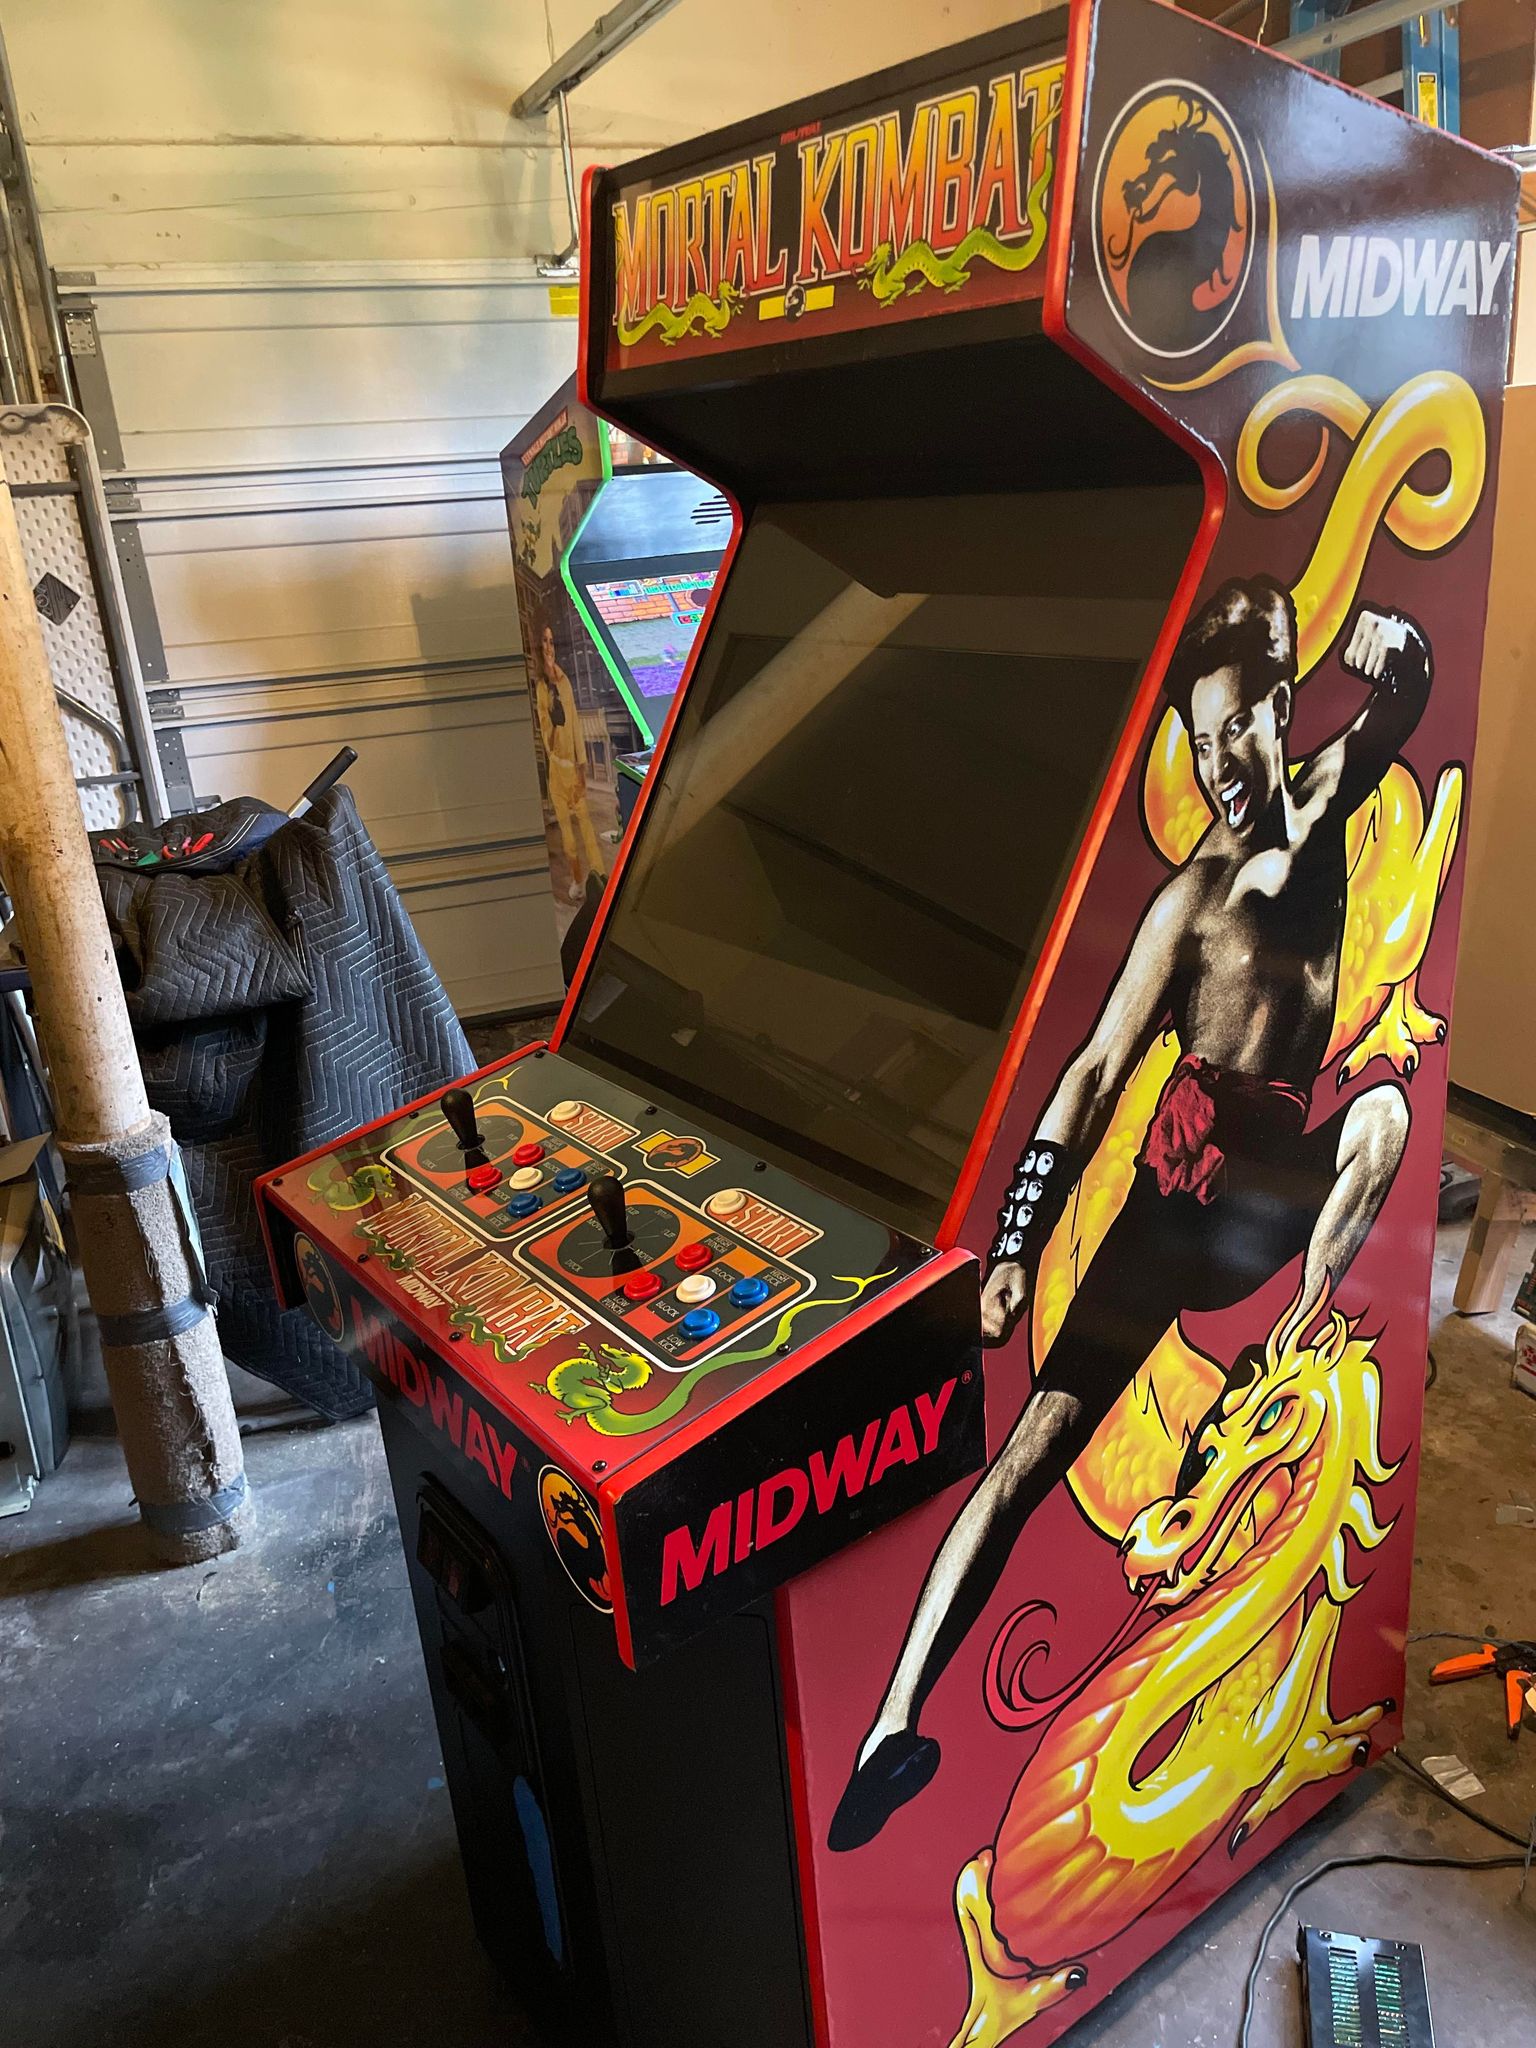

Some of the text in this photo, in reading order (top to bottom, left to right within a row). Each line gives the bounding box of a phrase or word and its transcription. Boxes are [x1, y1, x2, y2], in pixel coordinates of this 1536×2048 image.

[612, 57, 1066, 326] MORTAL KOMBAT
[1290, 235, 1511, 319] MIDWAY
[562, 1111, 636, 1150] START
[725, 1202, 815, 1253] START
[703, 1238, 728, 1254] PUNCH
[356, 1192, 591, 1361] MORTAL KOMBAT
[711, 1267, 735, 1284] BLOCK
[761, 1273, 782, 1288] KICK
[769, 1269, 791, 1284] HIGH
[395, 1274, 446, 1309] MIDWAY
[601, 1298, 626, 1316] PUNCH
[612, 1295, 631, 1308] LOW
[655, 1301, 681, 1319] BLOCK
[656, 1338, 679, 1355] KICK
[666, 1333, 686, 1348] LOW
[350, 1295, 518, 1502] MIDWAY
[660, 1377, 958, 1607] MIDWAY
